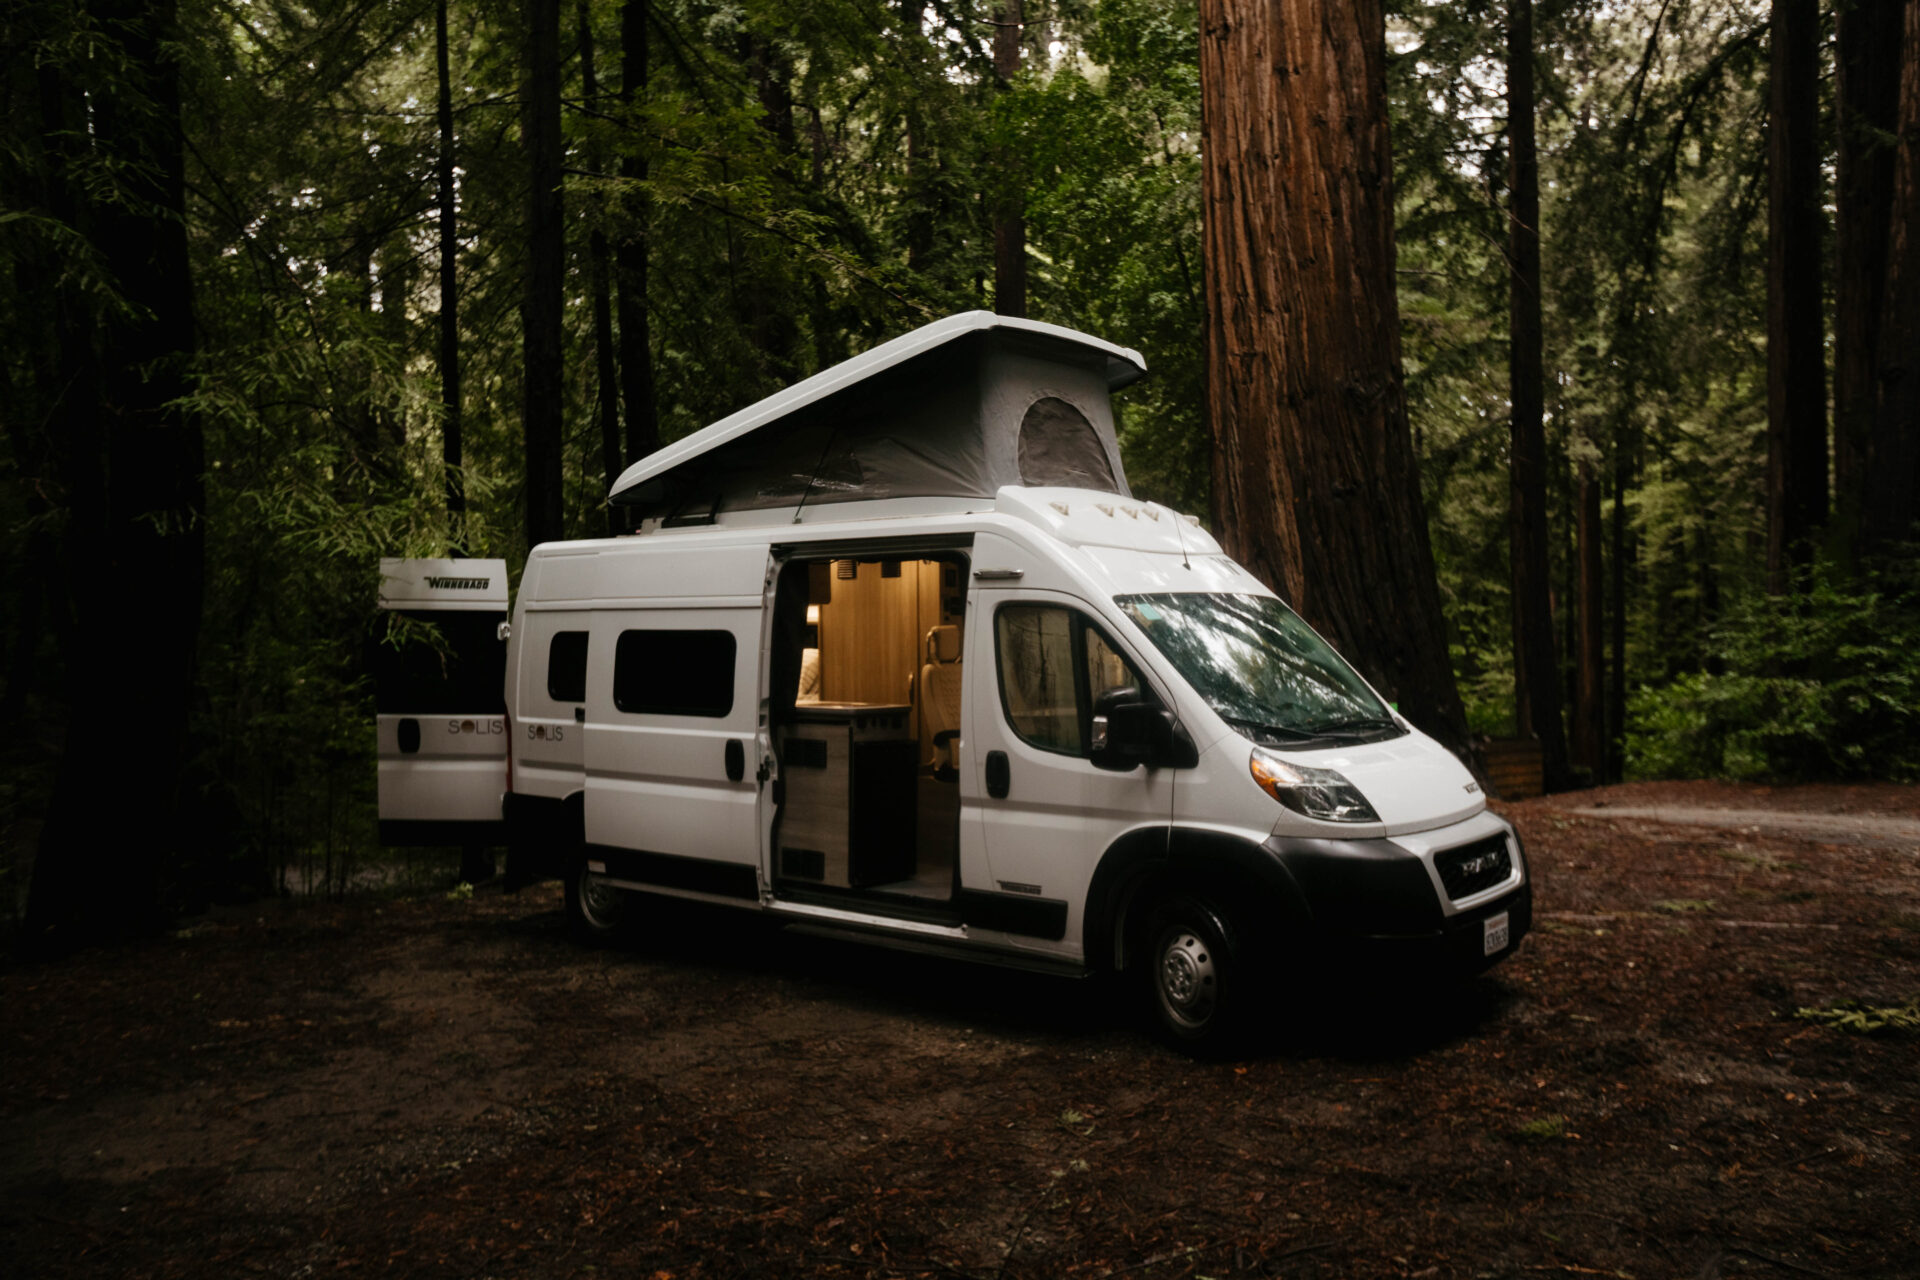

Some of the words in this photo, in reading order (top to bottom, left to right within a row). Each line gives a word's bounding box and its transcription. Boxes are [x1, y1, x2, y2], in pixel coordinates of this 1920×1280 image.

[424, 576, 490, 590] WINNEBAGO
[448, 719, 504, 735] SOLIS
[527, 724, 564, 742] SOLIS
